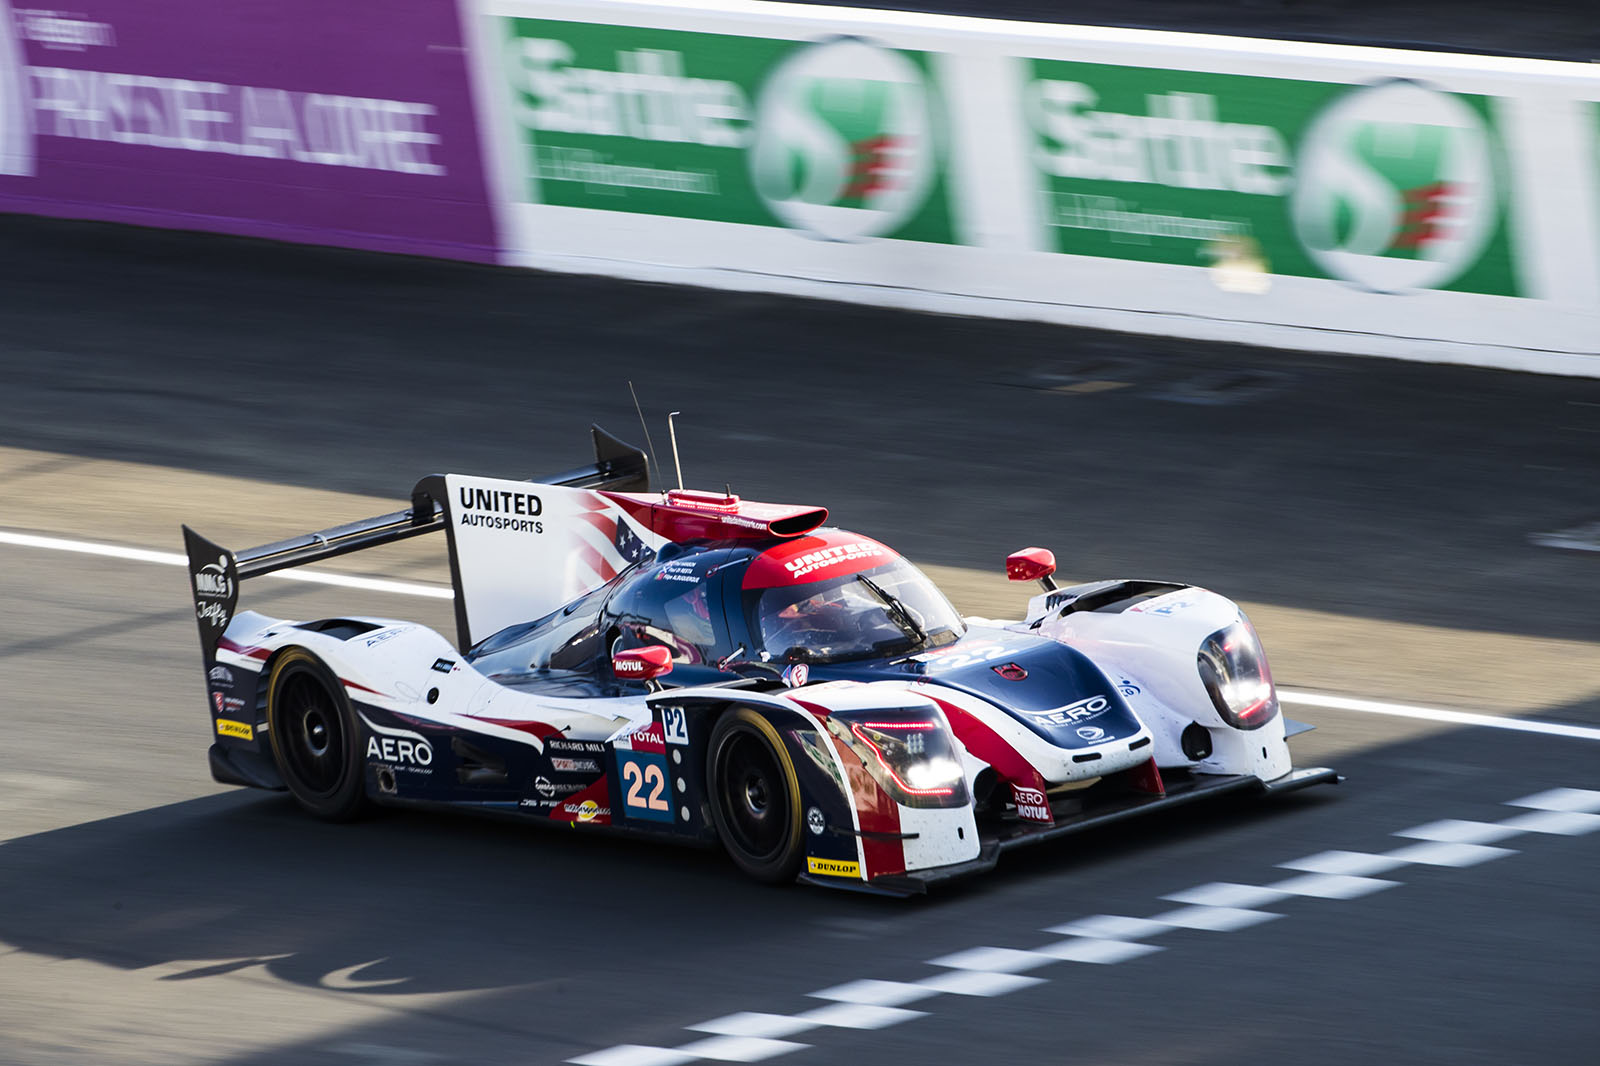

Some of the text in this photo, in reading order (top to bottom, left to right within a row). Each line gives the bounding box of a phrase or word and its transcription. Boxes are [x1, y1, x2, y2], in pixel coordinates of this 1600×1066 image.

[460, 487, 543, 516] UNITED
[461, 513, 543, 534] AUTOSPORTS
[784, 544, 878, 572] UNITED
[794, 551, 883, 578] AUTOSPORTS
[615, 661, 643, 671] MOTUL
[664, 707, 686, 737] P2
[1034, 698, 1107, 725] AERO
[550, 741, 584, 752] RICHARD
[633, 731, 664, 744] TOTAL
[366, 736, 432, 766] AERO
[623, 761, 669, 811] 22
[1015, 792, 1043, 805] AERO
[1018, 804, 1049, 820] MOTUL
[817, 862, 857, 873] DUNLOP
